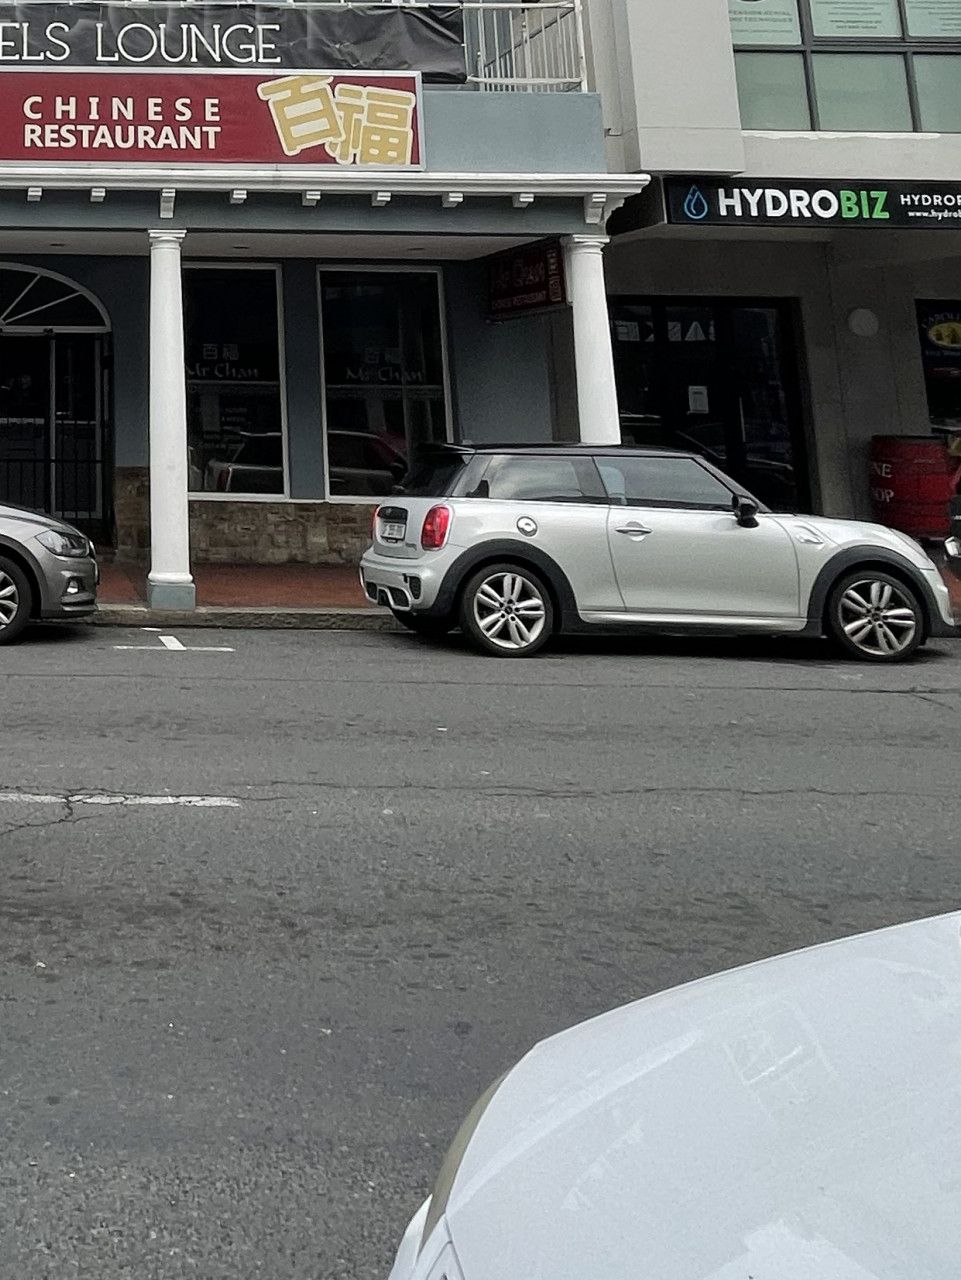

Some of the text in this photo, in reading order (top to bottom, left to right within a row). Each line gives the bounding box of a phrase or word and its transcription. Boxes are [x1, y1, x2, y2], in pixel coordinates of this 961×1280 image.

[95, 22, 282, 64] LOUNGE
[23, 95, 221, 122] CHINESE
[256, 75, 416, 166] 百福
[23, 123, 222, 150] RESTAURANT
[718, 189, 890, 220] HYDROBIZ
[214, 363, 259, 378] Chan
